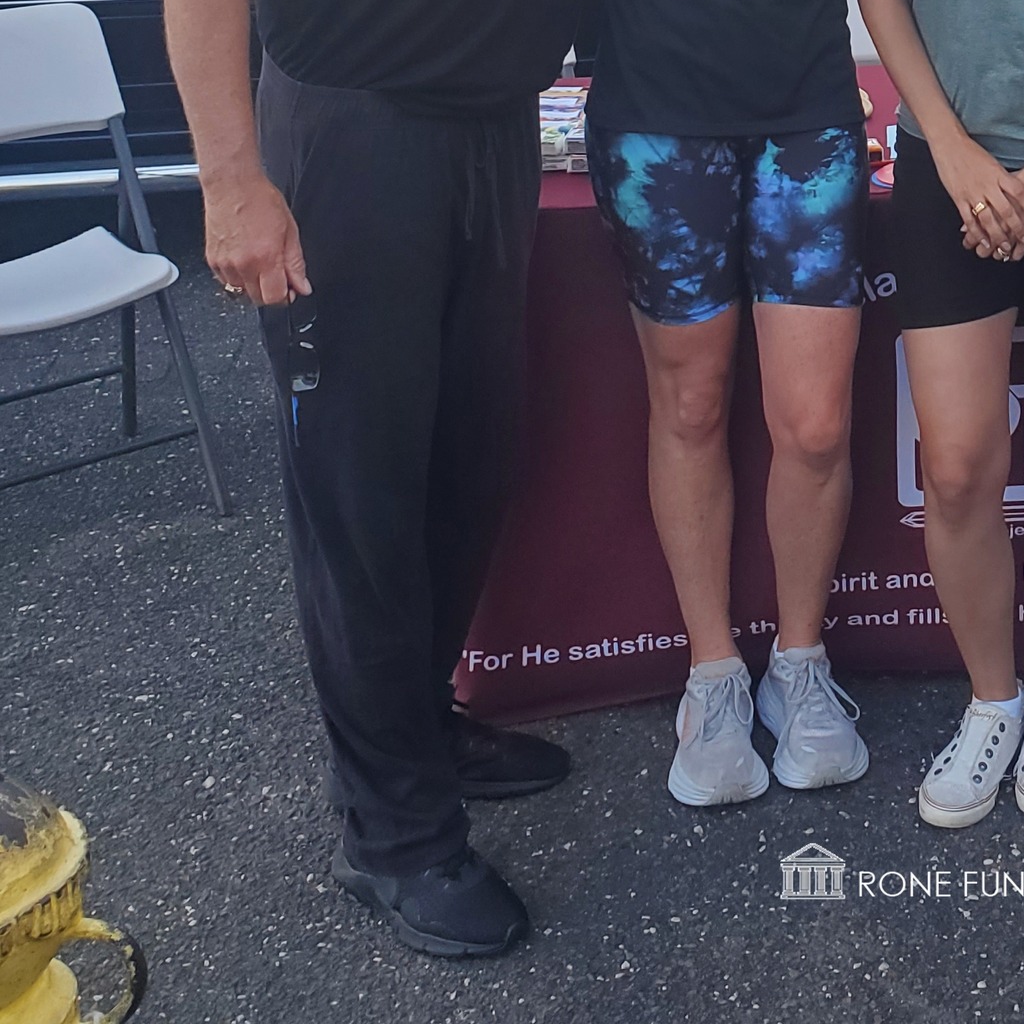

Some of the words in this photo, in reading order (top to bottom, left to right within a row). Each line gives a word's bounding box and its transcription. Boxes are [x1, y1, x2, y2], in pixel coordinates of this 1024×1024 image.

[521, 643, 560, 667] He
[568, 631, 689, 663] satisfies
[847, 609, 899, 626] and
